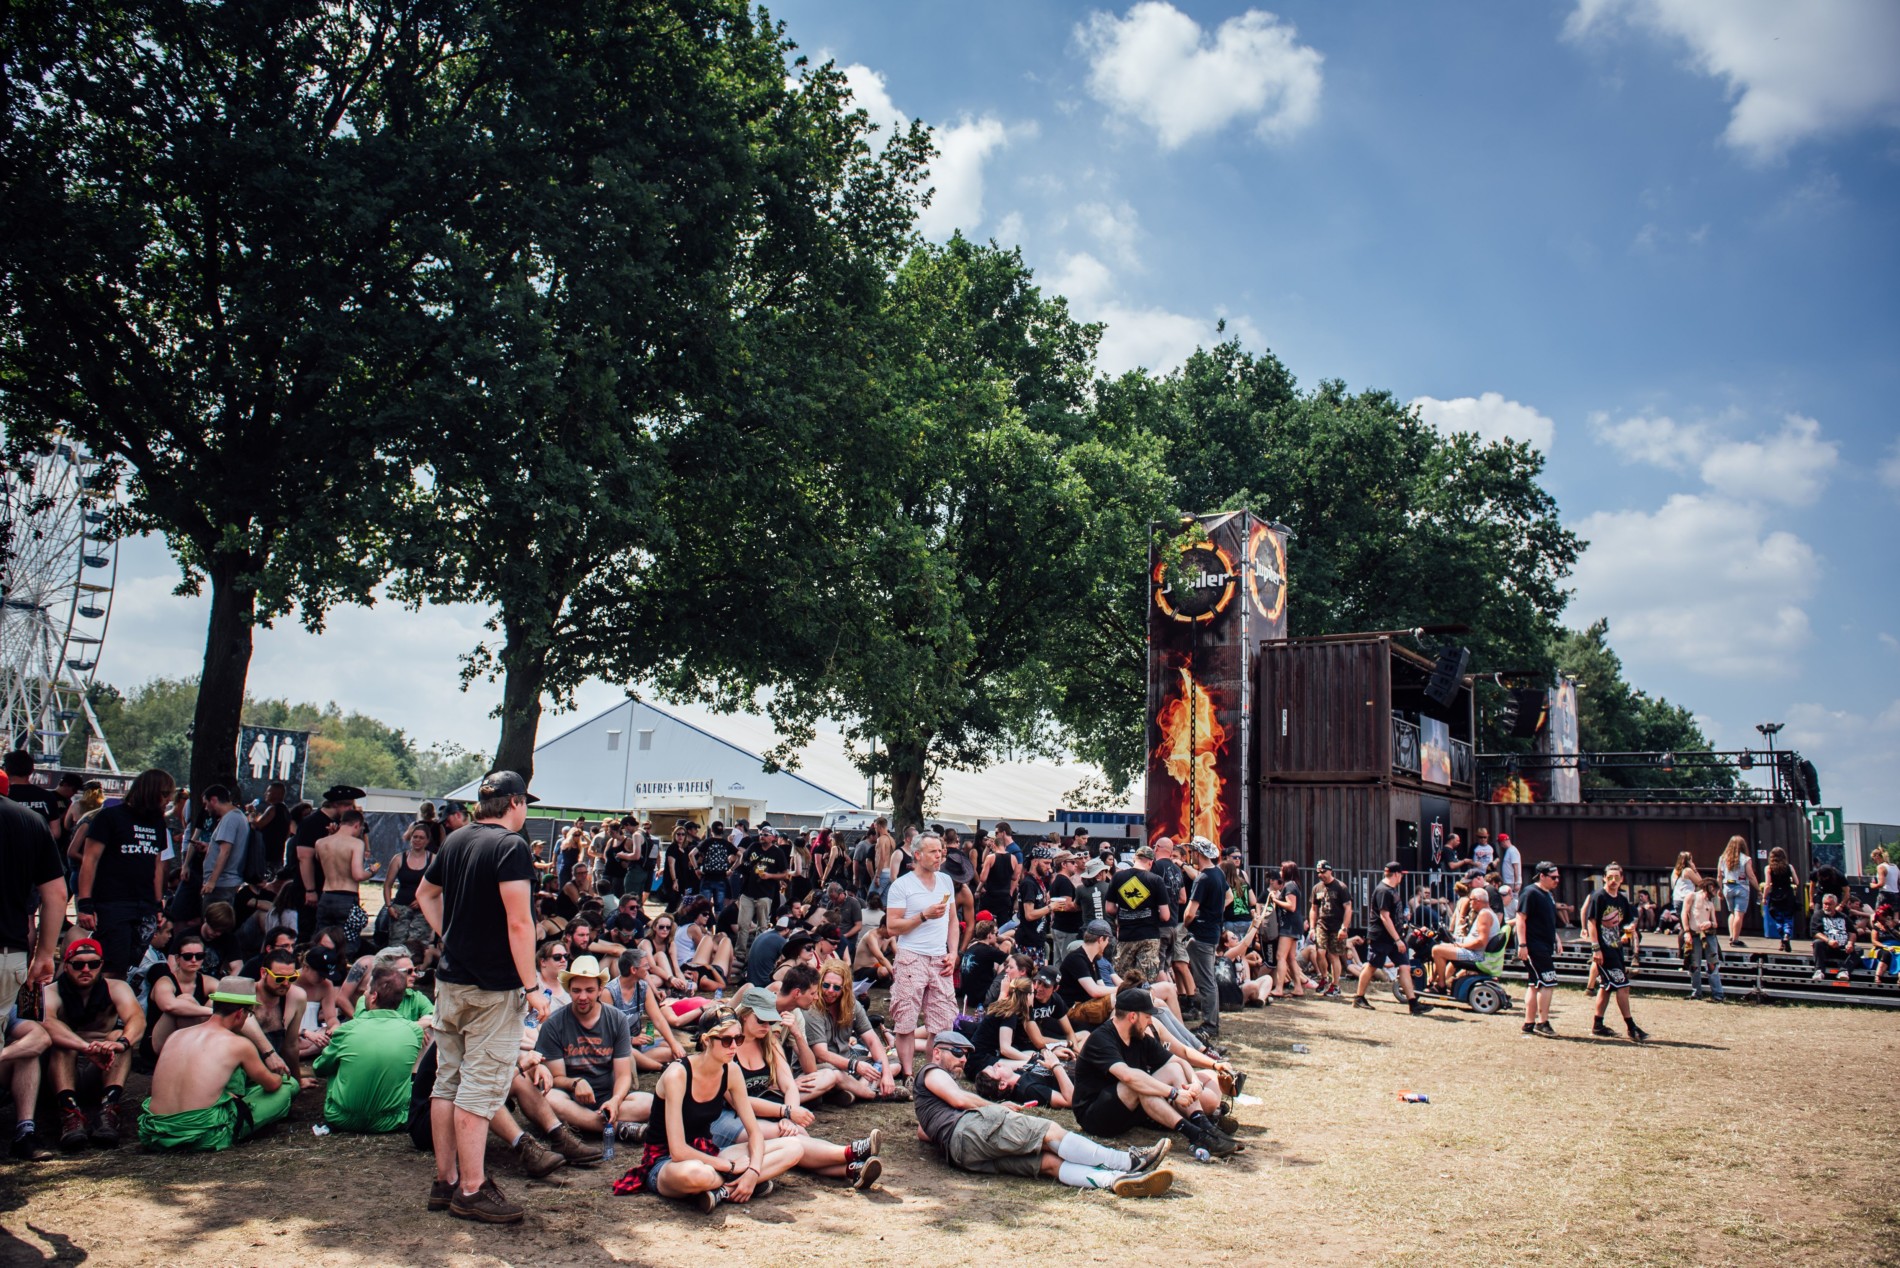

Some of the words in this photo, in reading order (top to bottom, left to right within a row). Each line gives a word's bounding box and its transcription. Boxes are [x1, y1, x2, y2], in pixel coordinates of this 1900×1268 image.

[1255, 558, 1280, 585] Jupiler
[1162, 571, 1230, 594] Jpiler
[636, 782, 672, 793] GAUFRES
[677, 781, 710, 792] WAFELS
[121, 845, 142, 854] SIX
[143, 846, 159, 855] PAC
